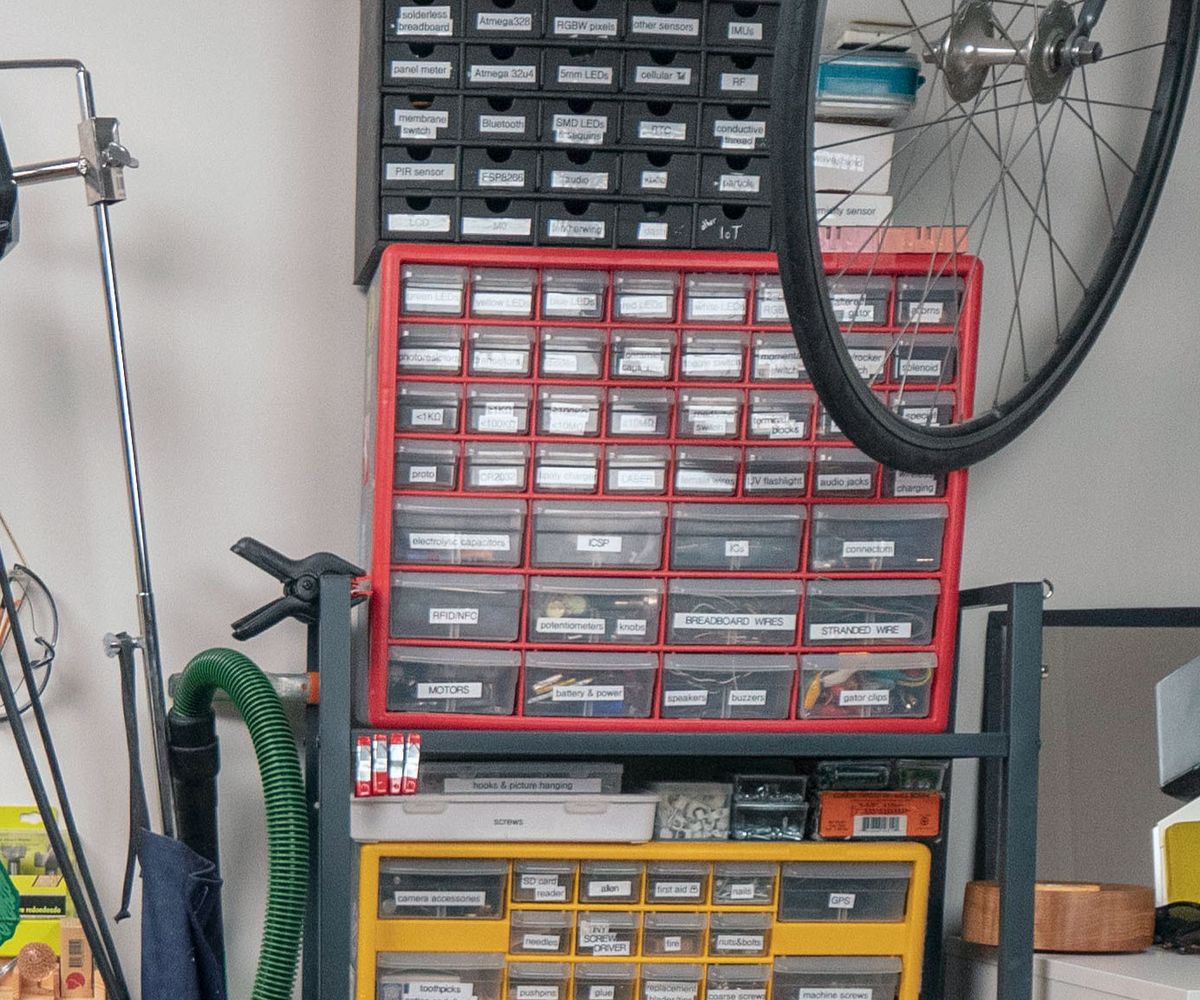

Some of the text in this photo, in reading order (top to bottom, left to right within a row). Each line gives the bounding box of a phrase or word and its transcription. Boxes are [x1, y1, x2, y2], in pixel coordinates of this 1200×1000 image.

[402, 10, 448, 20] solderless
[479, 14, 531, 27] Atmega328
[398, 22, 450, 32] breadboard
[557, 18, 615, 32] RGBW pixels
[634, 19, 693, 32] other sensors
[393, 65, 447, 75] panel meter
[474, 68, 535, 80] Atmega 32u4
[560, 69, 609, 81] 5mm LEDs
[640, 70, 673, 81] cellular
[732, 77, 746, 87] RF
[398, 113, 447, 124] membrane
[481, 119, 525, 129] Bluetooth
[555, 118, 605, 129] SMD LEDs
[403, 126, 431, 136] switch
[716, 124, 764, 134] conductive
[395, 166, 445, 177] PIR sensor
[846, 207, 877, 216] sensor
[719, 224, 743, 240] IoT
[771, 424, 800, 435] blocks
[411, 469, 436, 481] proto
[763, 475, 803, 486] flashlight
[819, 476, 870, 488] audio jacks
[896, 482, 934, 494] charging
[412, 537, 506, 549] electrolytic capacitors
[588, 538, 610, 548] ICSP
[845, 544, 893, 554] connectors
[432, 610, 479, 621] RFID/NFC
[540, 620, 646, 632] potentiometers knobs
[685, 616, 784, 627] BREADBOARD WIRES
[821, 625, 899, 636] STRANDED WIRE
[428, 685, 470, 695] MOTORS
[555, 687, 585, 699] battery
[596, 689, 623, 700] power
[667, 692, 707, 703] speakers
[731, 691, 766, 702] buzzers
[843, 691, 888, 703] gator clips
[473, 780, 499, 790] hooks
[508, 781, 538, 792] picture
[539, 780, 573, 792] hanging
[493, 818, 524, 826] screws
[523, 876, 558, 886] SD card
[536, 888, 565, 898] reader
[600, 883, 620, 893] allen
[657, 884, 688, 894] first aid
[732, 886, 753, 896] nails
[397, 894, 482, 903] camera accessories
[831, 895, 850, 906] GPS
[525, 937, 559, 947] needles
[666, 938, 680, 948] fire
[718, 938, 762, 948] nuts&bolts
[593, 943, 627, 953] DRIVER
[419, 984, 462, 995] toothpicks
[519, 988, 557, 999] pushpins
[594, 988, 613, 999] glue
[647, 983, 697, 995] replacement
[708, 992, 736, 1000] coarse
[803, 990, 869, 1000] machine screws
